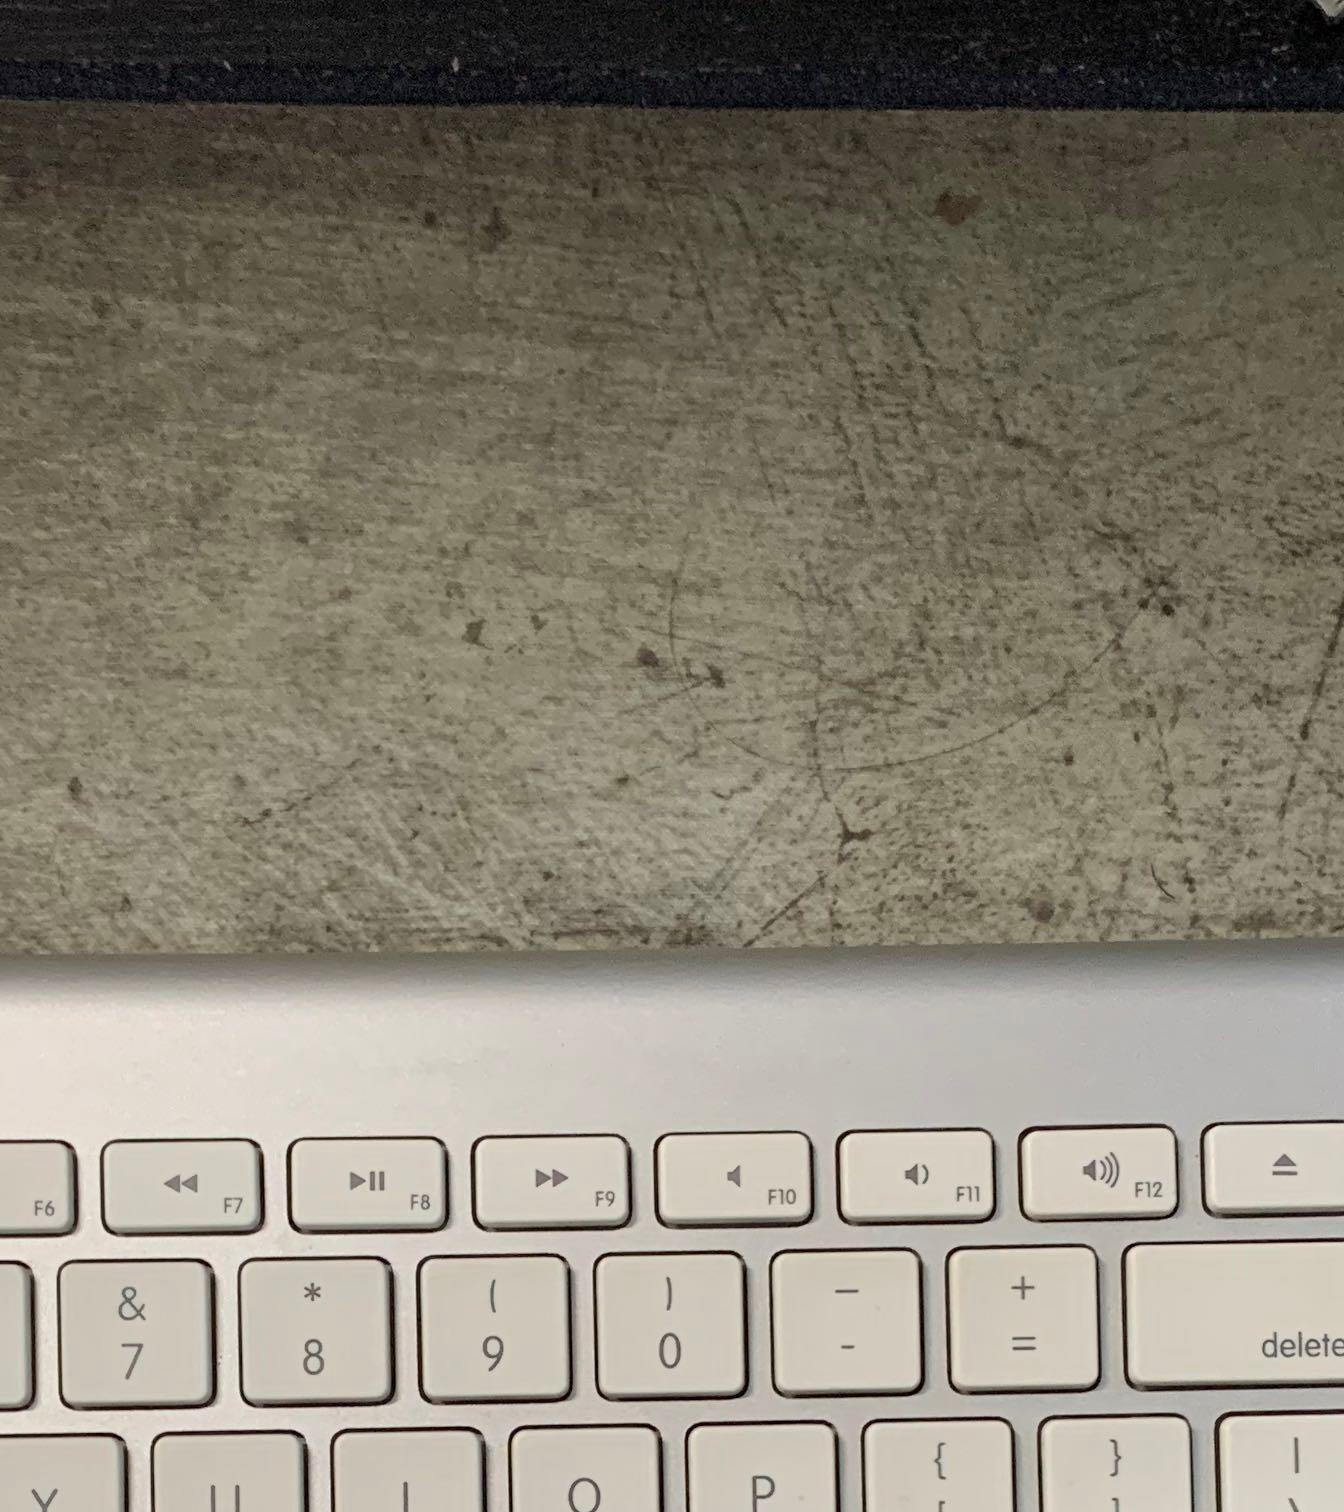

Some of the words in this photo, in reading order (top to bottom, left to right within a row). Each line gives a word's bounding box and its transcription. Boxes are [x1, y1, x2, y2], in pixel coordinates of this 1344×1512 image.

[409, 1192, 432, 1212] F8
[594, 1189, 617, 1208] F9
[766, 1187, 798, 1207] F10
[955, 1184, 981, 1203] F11
[1133, 1180, 1164, 1199] F12
[33, 1198, 56, 1218] F6
[222, 1196, 245, 1215] F7
[488, 1278, 498, 1315] (
[664, 1275, 674, 1313] )
[1010, 1275, 1036, 1301] +
[117, 1286, 147, 1321] &
[301, 1337, 326, 1377] 8
[481, 1334, 506, 1373] 9
[657, 1331, 683, 1371] 0
[1010, 1335, 1038, 1352] =
[120, 1341, 145, 1382] 7
[932, 1440, 948, 1482] {
[1108, 1437, 1123, 1479] }
